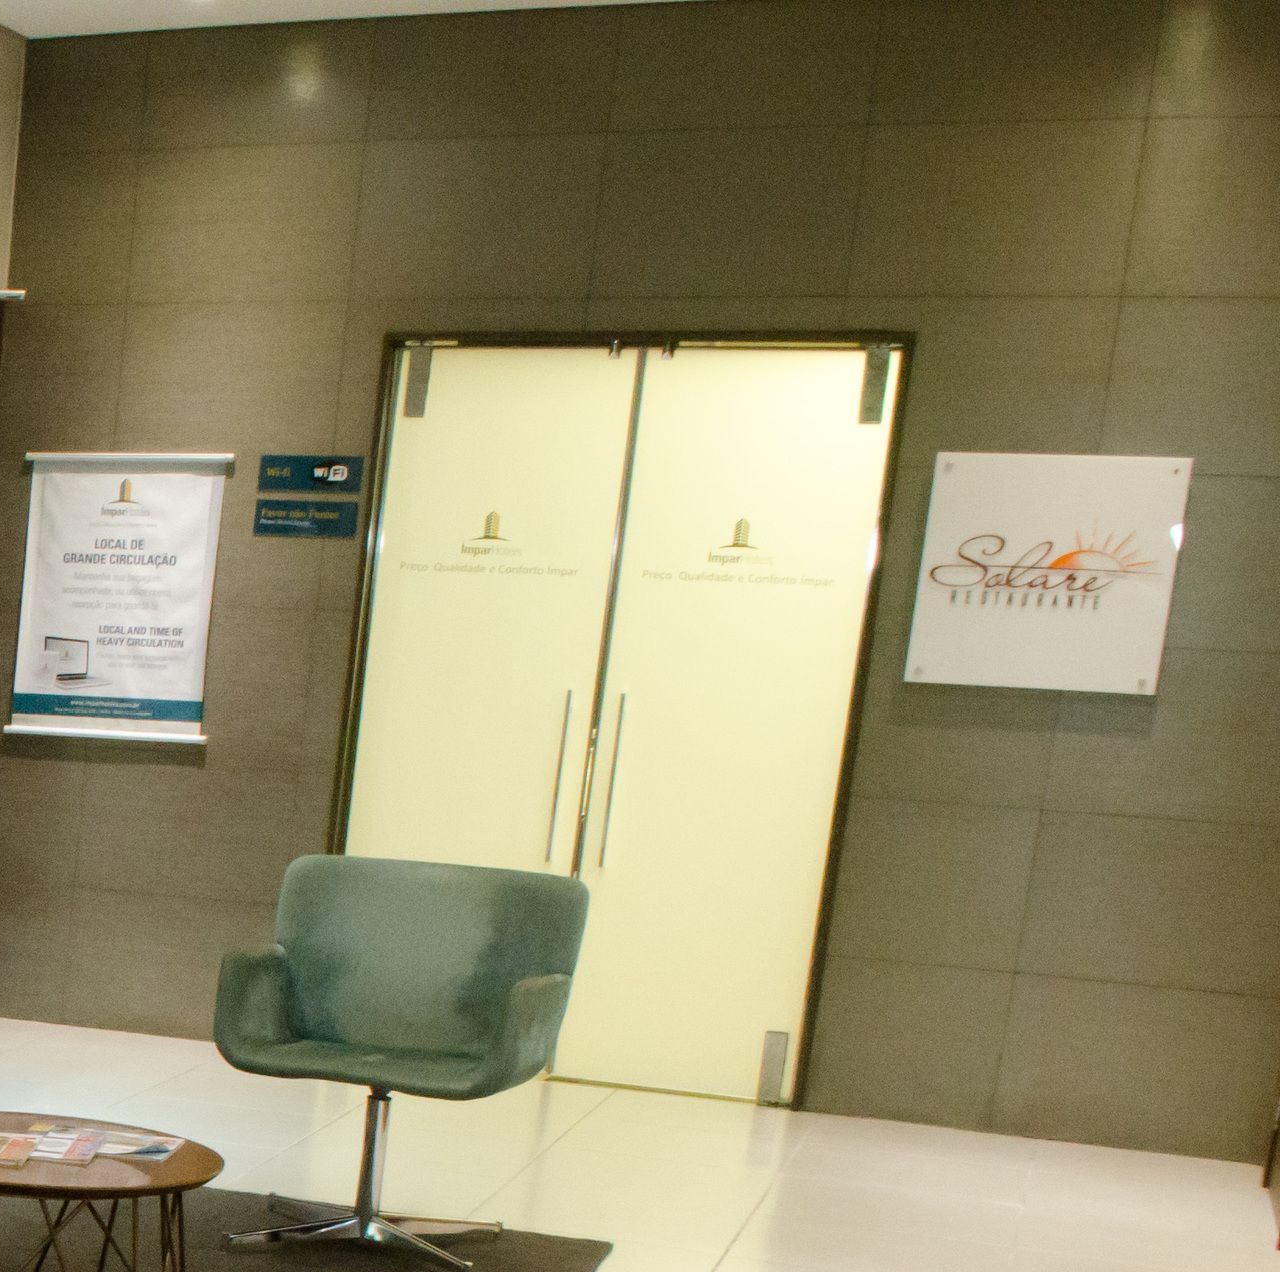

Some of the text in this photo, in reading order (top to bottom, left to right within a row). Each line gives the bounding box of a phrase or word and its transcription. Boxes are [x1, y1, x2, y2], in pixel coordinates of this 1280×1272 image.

[94, 538, 145, 550] LOCAL DE
[63, 552, 177, 568] GRANDE CIRCULAÇÃO
[929, 534, 1114, 593] Solare
[498, 564, 544, 576] Conforto
[678, 570, 735, 583] Qualidade
[747, 573, 796, 585] Conforto
[949, 590, 1101, 610] RESTAURANTE
[98, 625, 125, 635] LOCAL
[127, 626, 147, 635] AND
[149, 627, 170, 636] TIME
[96, 637, 184, 648] HEAVY CIRCULATION
